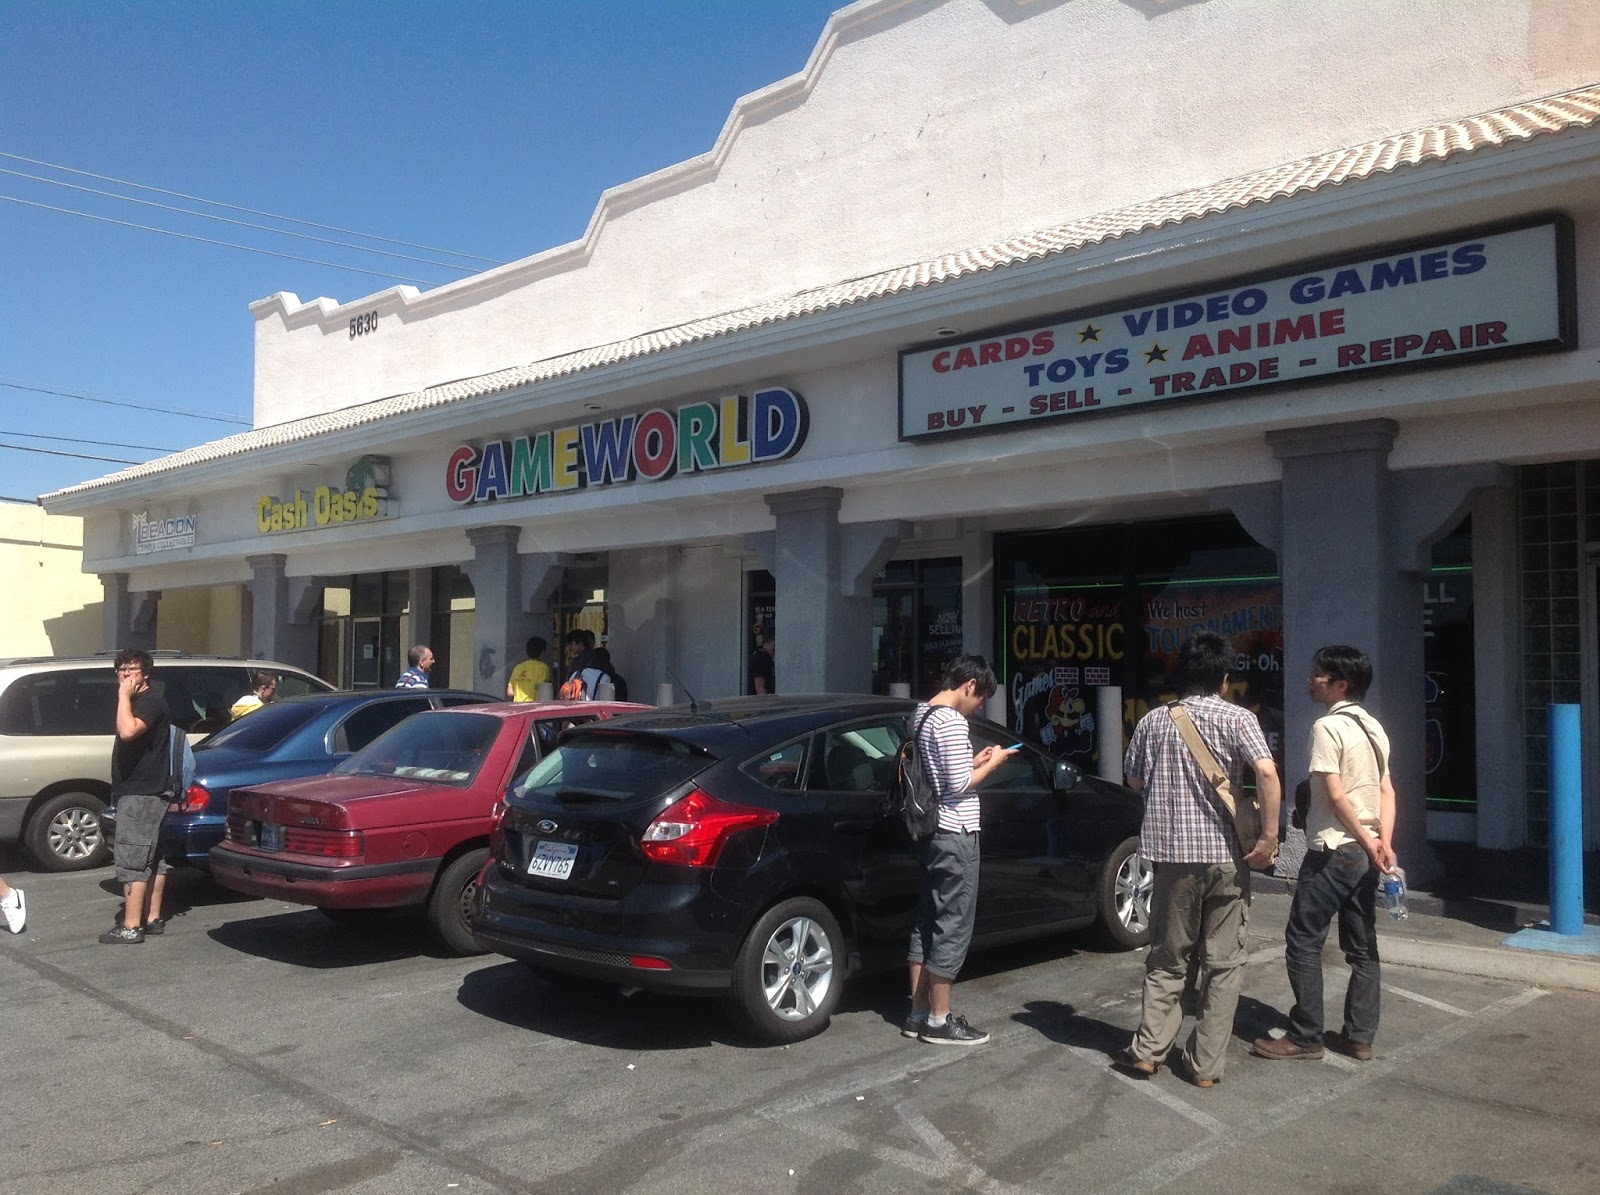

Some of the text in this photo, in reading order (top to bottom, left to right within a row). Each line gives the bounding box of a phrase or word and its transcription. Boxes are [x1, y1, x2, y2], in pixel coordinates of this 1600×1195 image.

[349, 310, 378, 338] 5630
[932, 243, 1487, 374] CARDS VIDEO GAMES
[1023, 308, 1345, 387] TOYS ANIME
[927, 404, 987, 430] BUY
[1029, 387, 1101, 415] SELL
[1150, 356, 1279, 397] TRADE
[1337, 320, 1509, 367] REPAIR
[446, 385, 804, 504] GAMEWORLD
[141, 514, 196, 540] BEACON
[257, 485, 378, 533] Cash Oasis
[1013, 597, 1086, 622] RETRO
[1147, 601, 1207, 620] We host
[1012, 623, 1125, 661] CLASSIC
